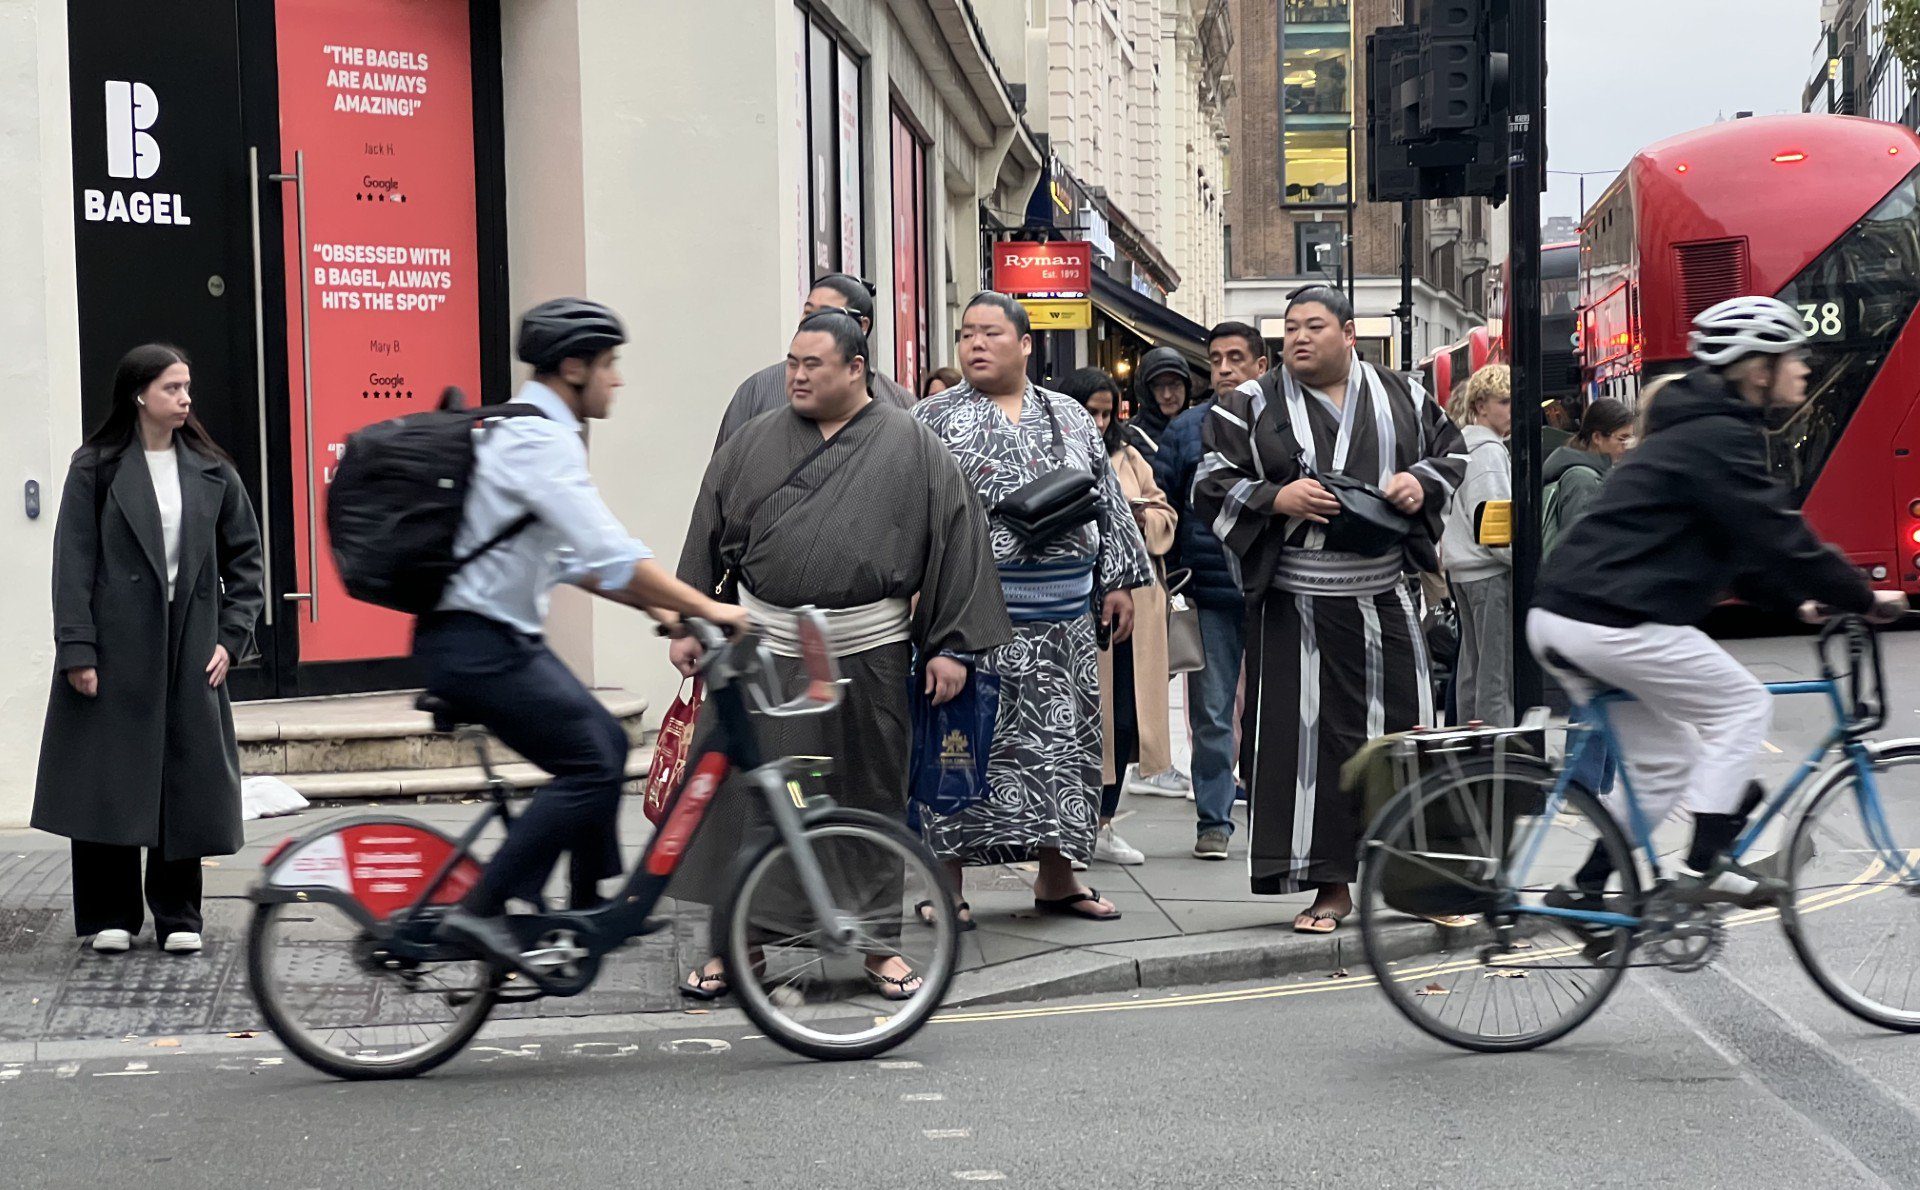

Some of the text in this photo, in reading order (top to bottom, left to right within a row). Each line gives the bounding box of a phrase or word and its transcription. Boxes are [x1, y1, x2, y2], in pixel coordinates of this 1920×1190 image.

[323, 45, 429, 71] “THE BAGELS
[326, 69, 427, 94] ARE ALWAYS
[334, 93, 421, 116] AMAZING!”
[105, 80, 161, 179] B
[364, 142, 385, 155] Jack
[363, 175, 399, 192] Google
[84, 189, 191, 225] BAGEL
[313, 243, 451, 266] “OBSESSED WITH
[1004, 254, 1082, 268] Ryman
[314, 268, 451, 289] B BAGEL, ALWAYS
[1042, 269, 1080, 279] Est. 1893
[322, 291, 446, 312] HITS THE SPOT”
[1796, 302, 1842, 337] 38
[370, 340, 391, 356] Mary
[370, 373, 405, 388] Google
